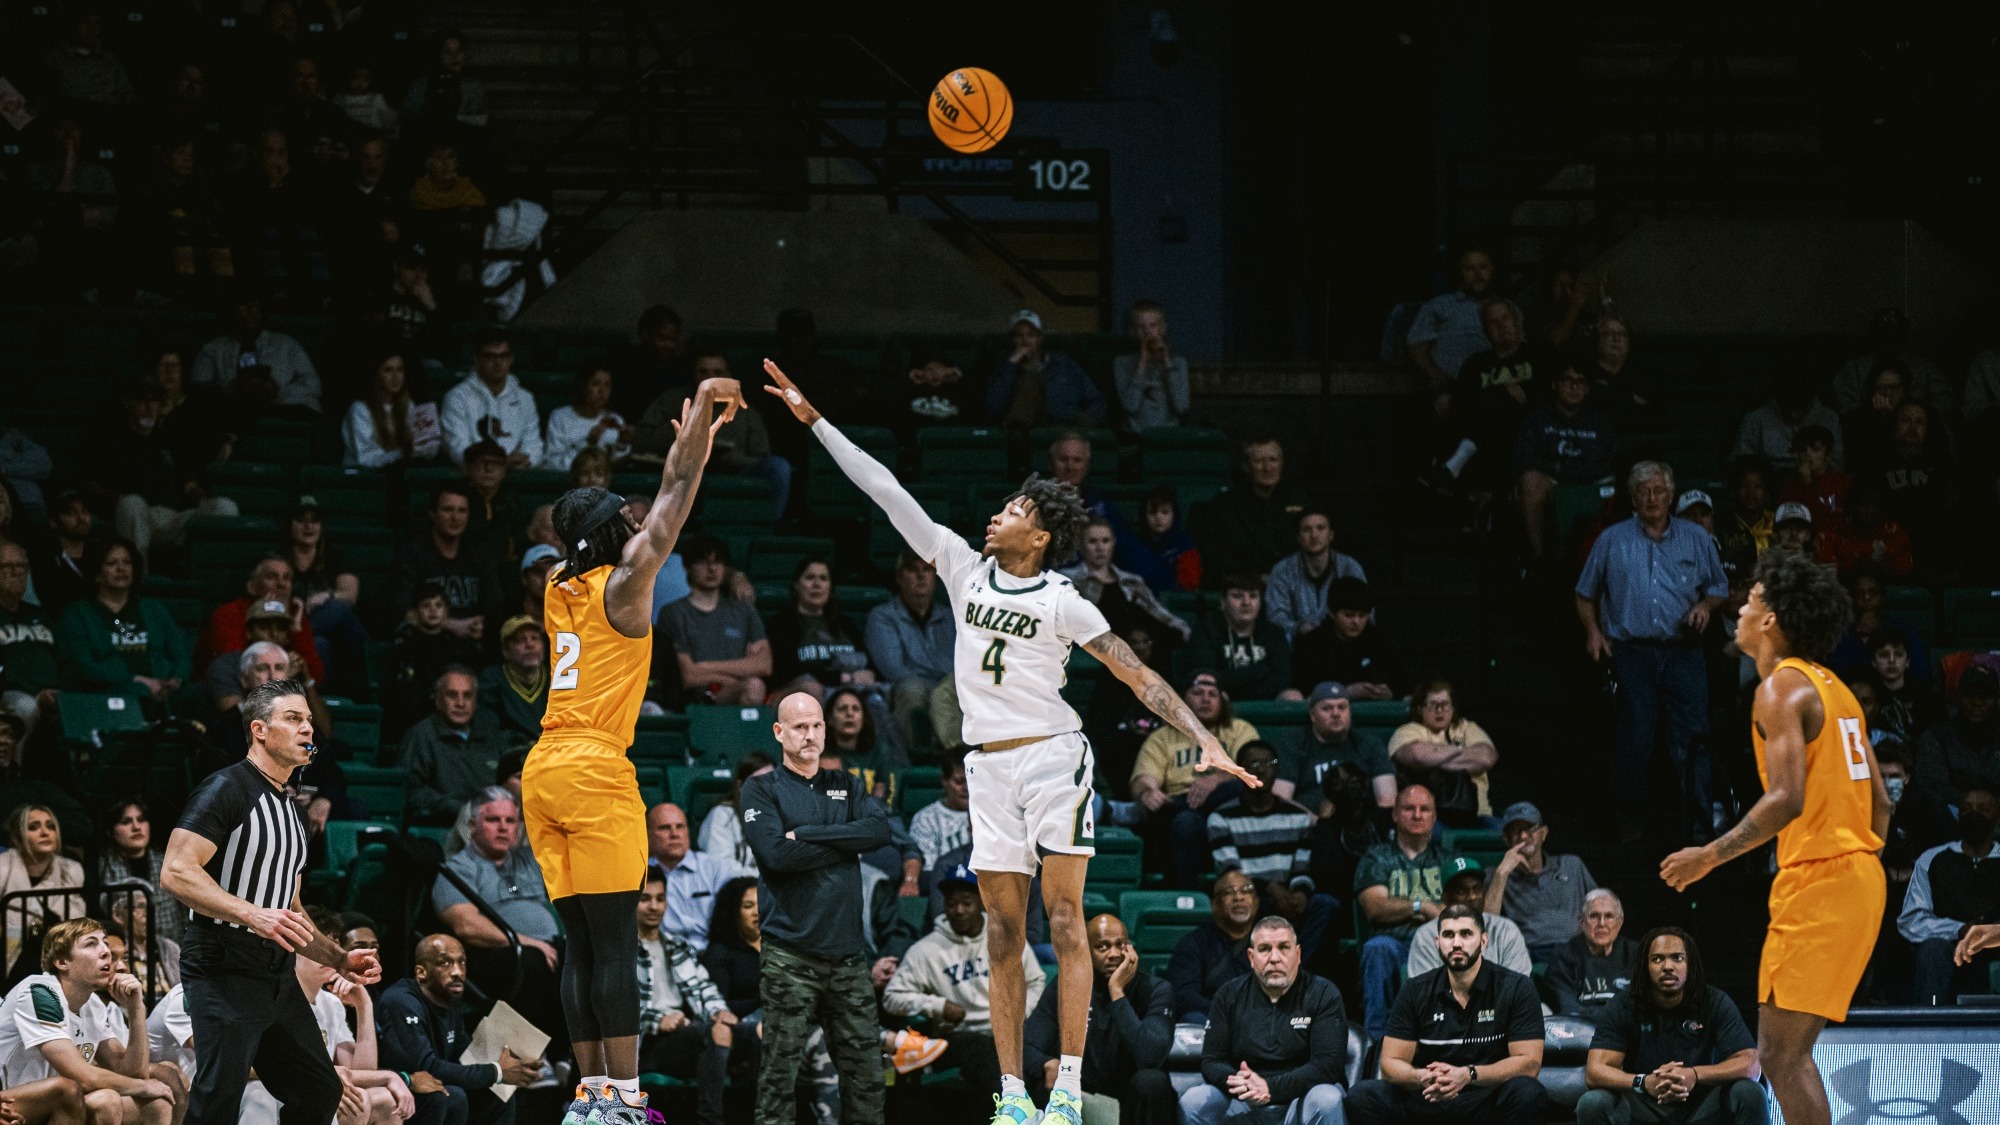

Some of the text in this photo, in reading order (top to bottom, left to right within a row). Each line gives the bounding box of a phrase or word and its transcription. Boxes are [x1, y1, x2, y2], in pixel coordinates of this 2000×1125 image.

[1028, 159, 1092, 191] 102
[964, 602, 1042, 639] BLAZERS
[551, 632, 582, 690] 2
[981, 636, 1007, 688] 4
